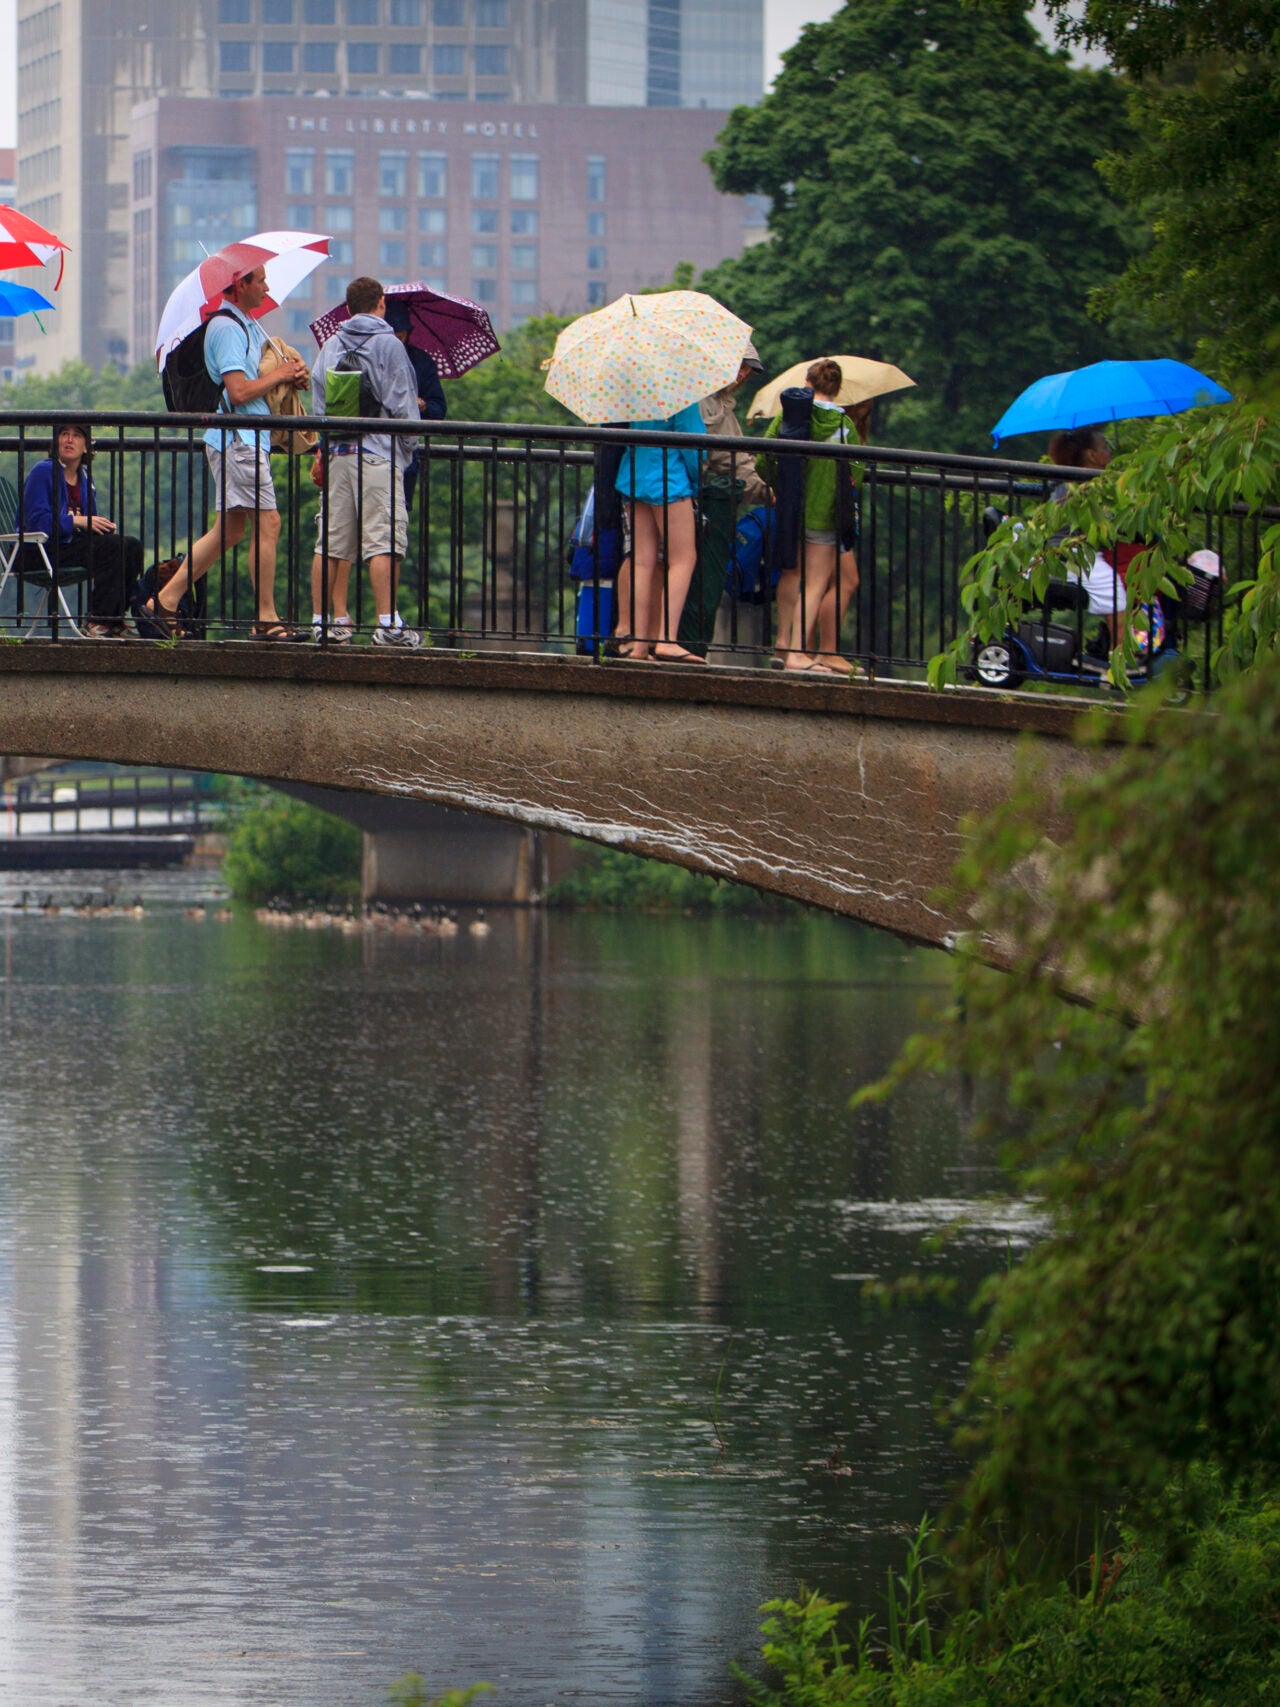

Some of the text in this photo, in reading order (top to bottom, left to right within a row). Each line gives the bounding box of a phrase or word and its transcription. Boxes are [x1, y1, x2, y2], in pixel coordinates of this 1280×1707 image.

[288, 116, 538, 138] THE LIBERTY HOTEL
